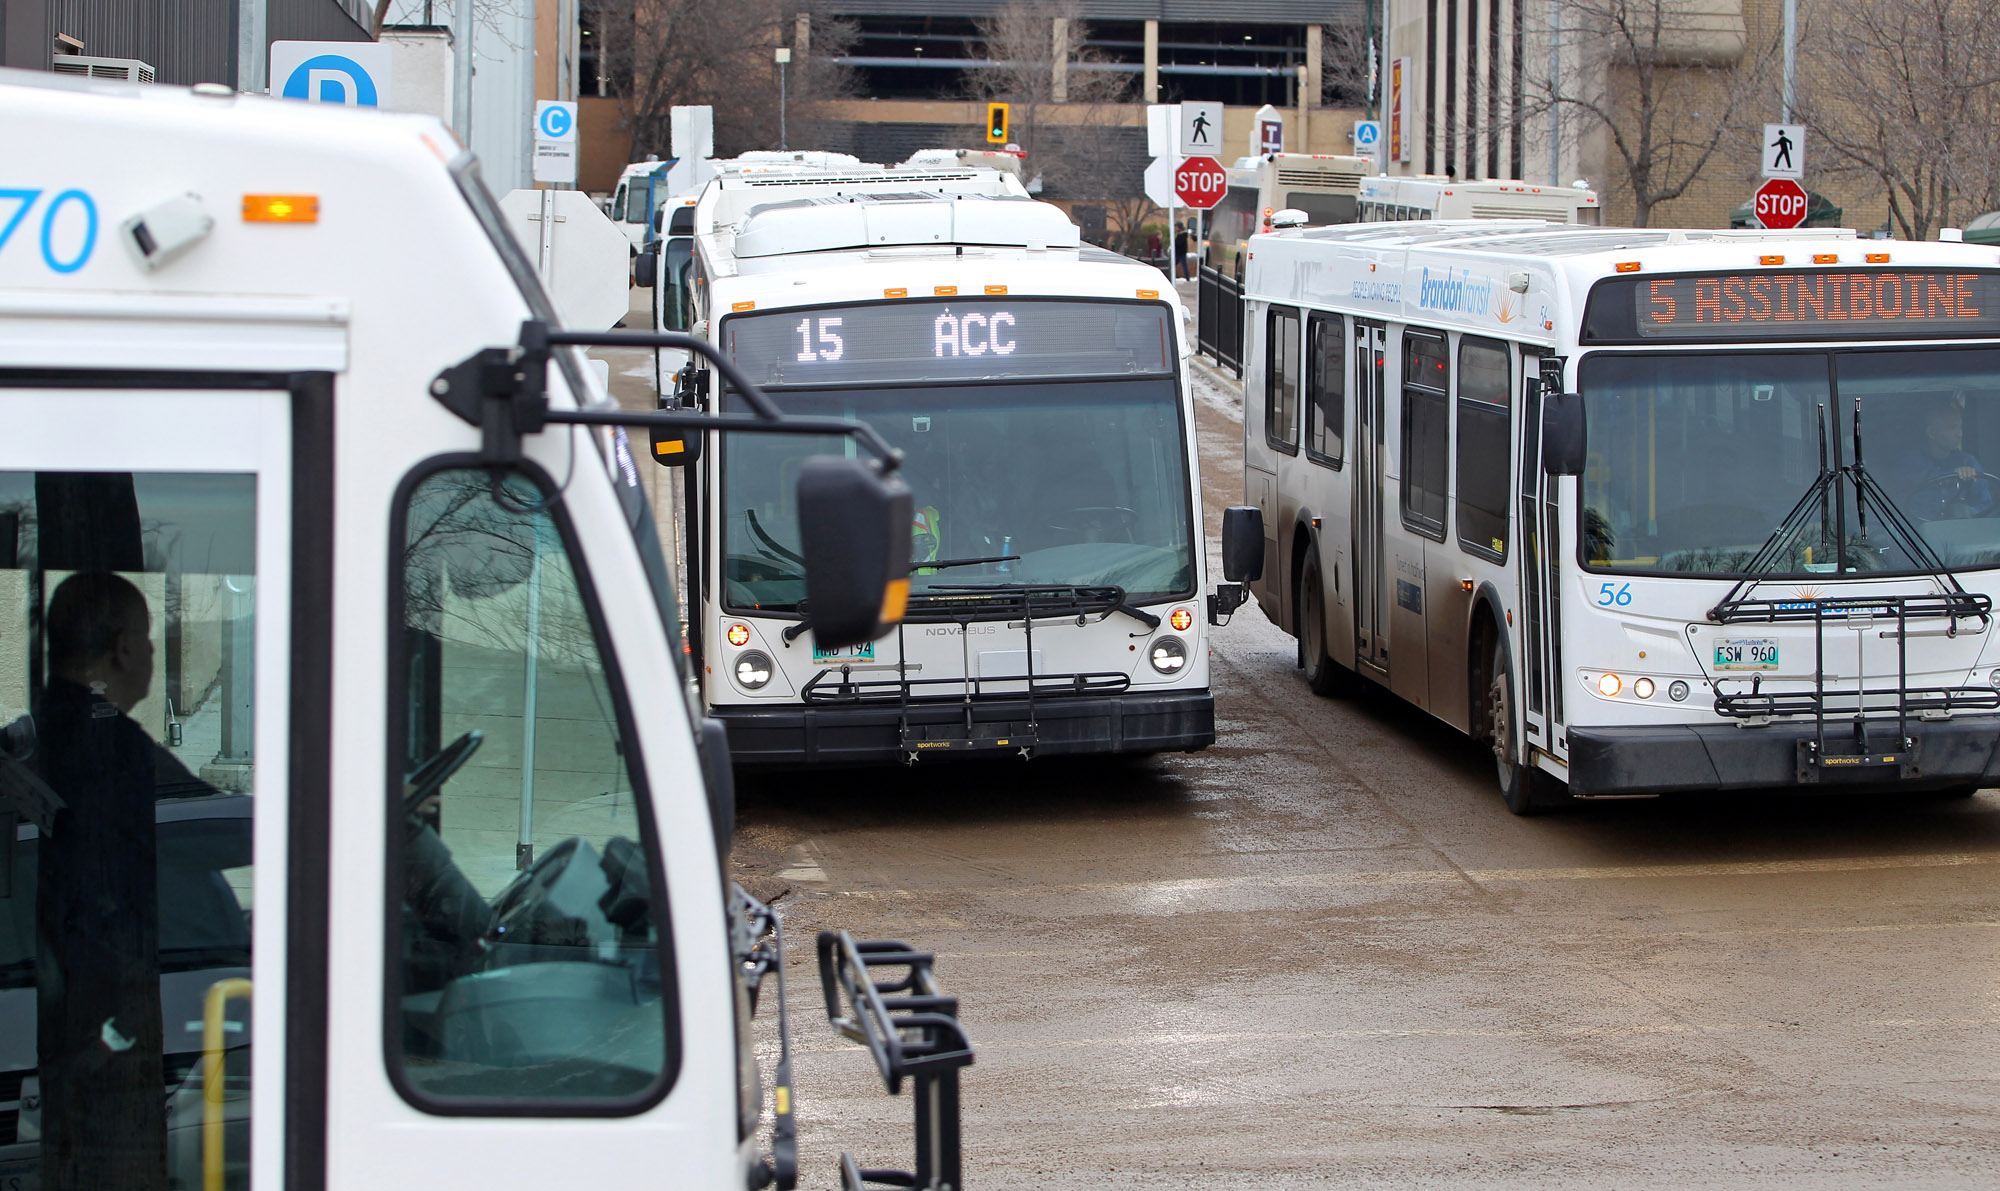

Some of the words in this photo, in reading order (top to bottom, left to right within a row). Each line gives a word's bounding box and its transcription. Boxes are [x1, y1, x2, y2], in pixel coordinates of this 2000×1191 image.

[547, 109, 564, 133] C
[1362, 126, 1374, 141] A
[1177, 172, 1225, 192] STOP
[1757, 193, 1805, 216] STOP
[1650, 279, 1677, 323] 5
[1695, 273, 1980, 322] ASSINIBOINE
[796, 317, 844, 361] 15
[934, 311, 1016, 357] ACC
[1597, 582, 1632, 606] 56
[1717, 646, 1742, 662] FSW
[1751, 646, 1776, 662] 960
[917, 741, 951, 749] sportworks
[1825, 757, 1860, 765] sportworks
